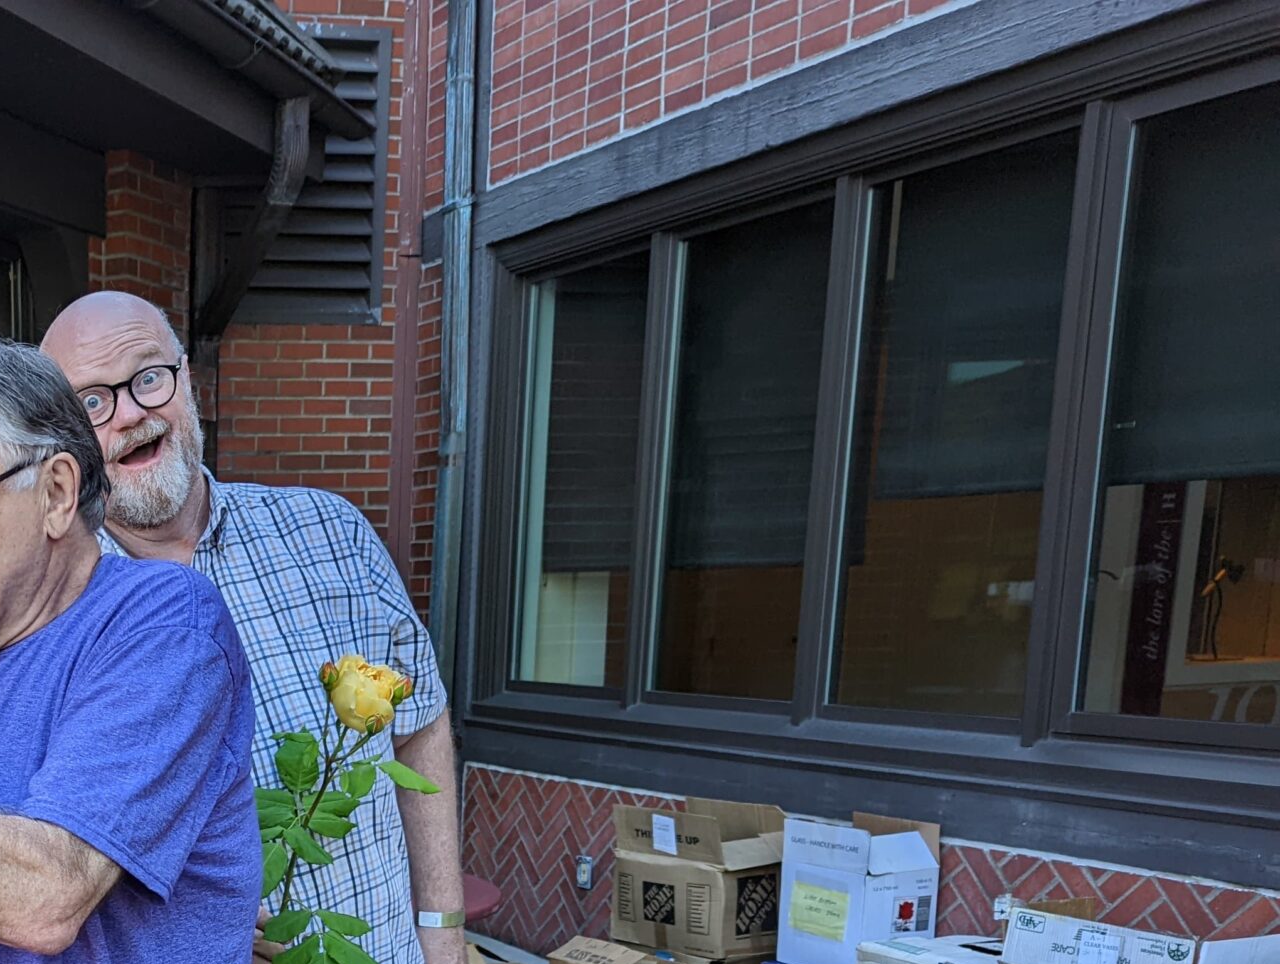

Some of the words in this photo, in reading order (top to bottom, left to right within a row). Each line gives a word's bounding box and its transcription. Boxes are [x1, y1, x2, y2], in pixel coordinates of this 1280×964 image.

[685, 836, 700, 846] UP
[810, 839, 831, 849] HANDLE
[831, 842, 845, 851] WITH
[845, 844, 860, 853] CARE
[645, 885, 660, 901] THE
[644, 885, 674, 919] HOME
[736, 873, 777, 934] HOME
[1051, 943, 1076, 956] CARE
[1083, 941, 1102, 949] CLEAR
[1102, 943, 1119, 951] VASES
